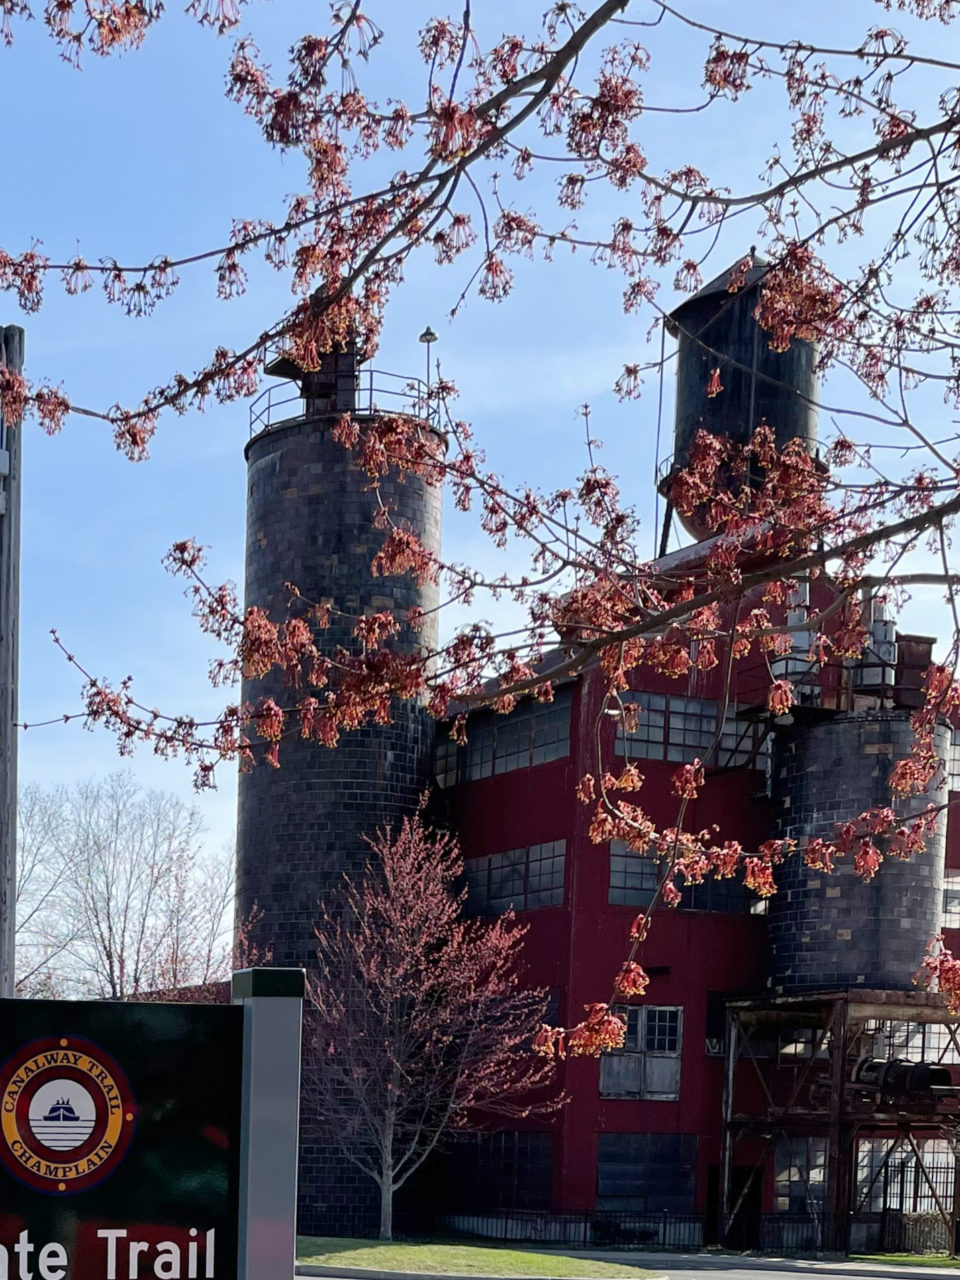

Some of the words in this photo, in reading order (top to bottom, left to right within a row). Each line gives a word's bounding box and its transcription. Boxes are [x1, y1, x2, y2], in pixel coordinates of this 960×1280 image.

[4, 1051, 83, 1114] CANALWAY
[88, 1057, 118, 1116] TRAIL
[10, 1139, 114, 1178] CHAMPLAIN
[97, 1227, 215, 1280] Trail
